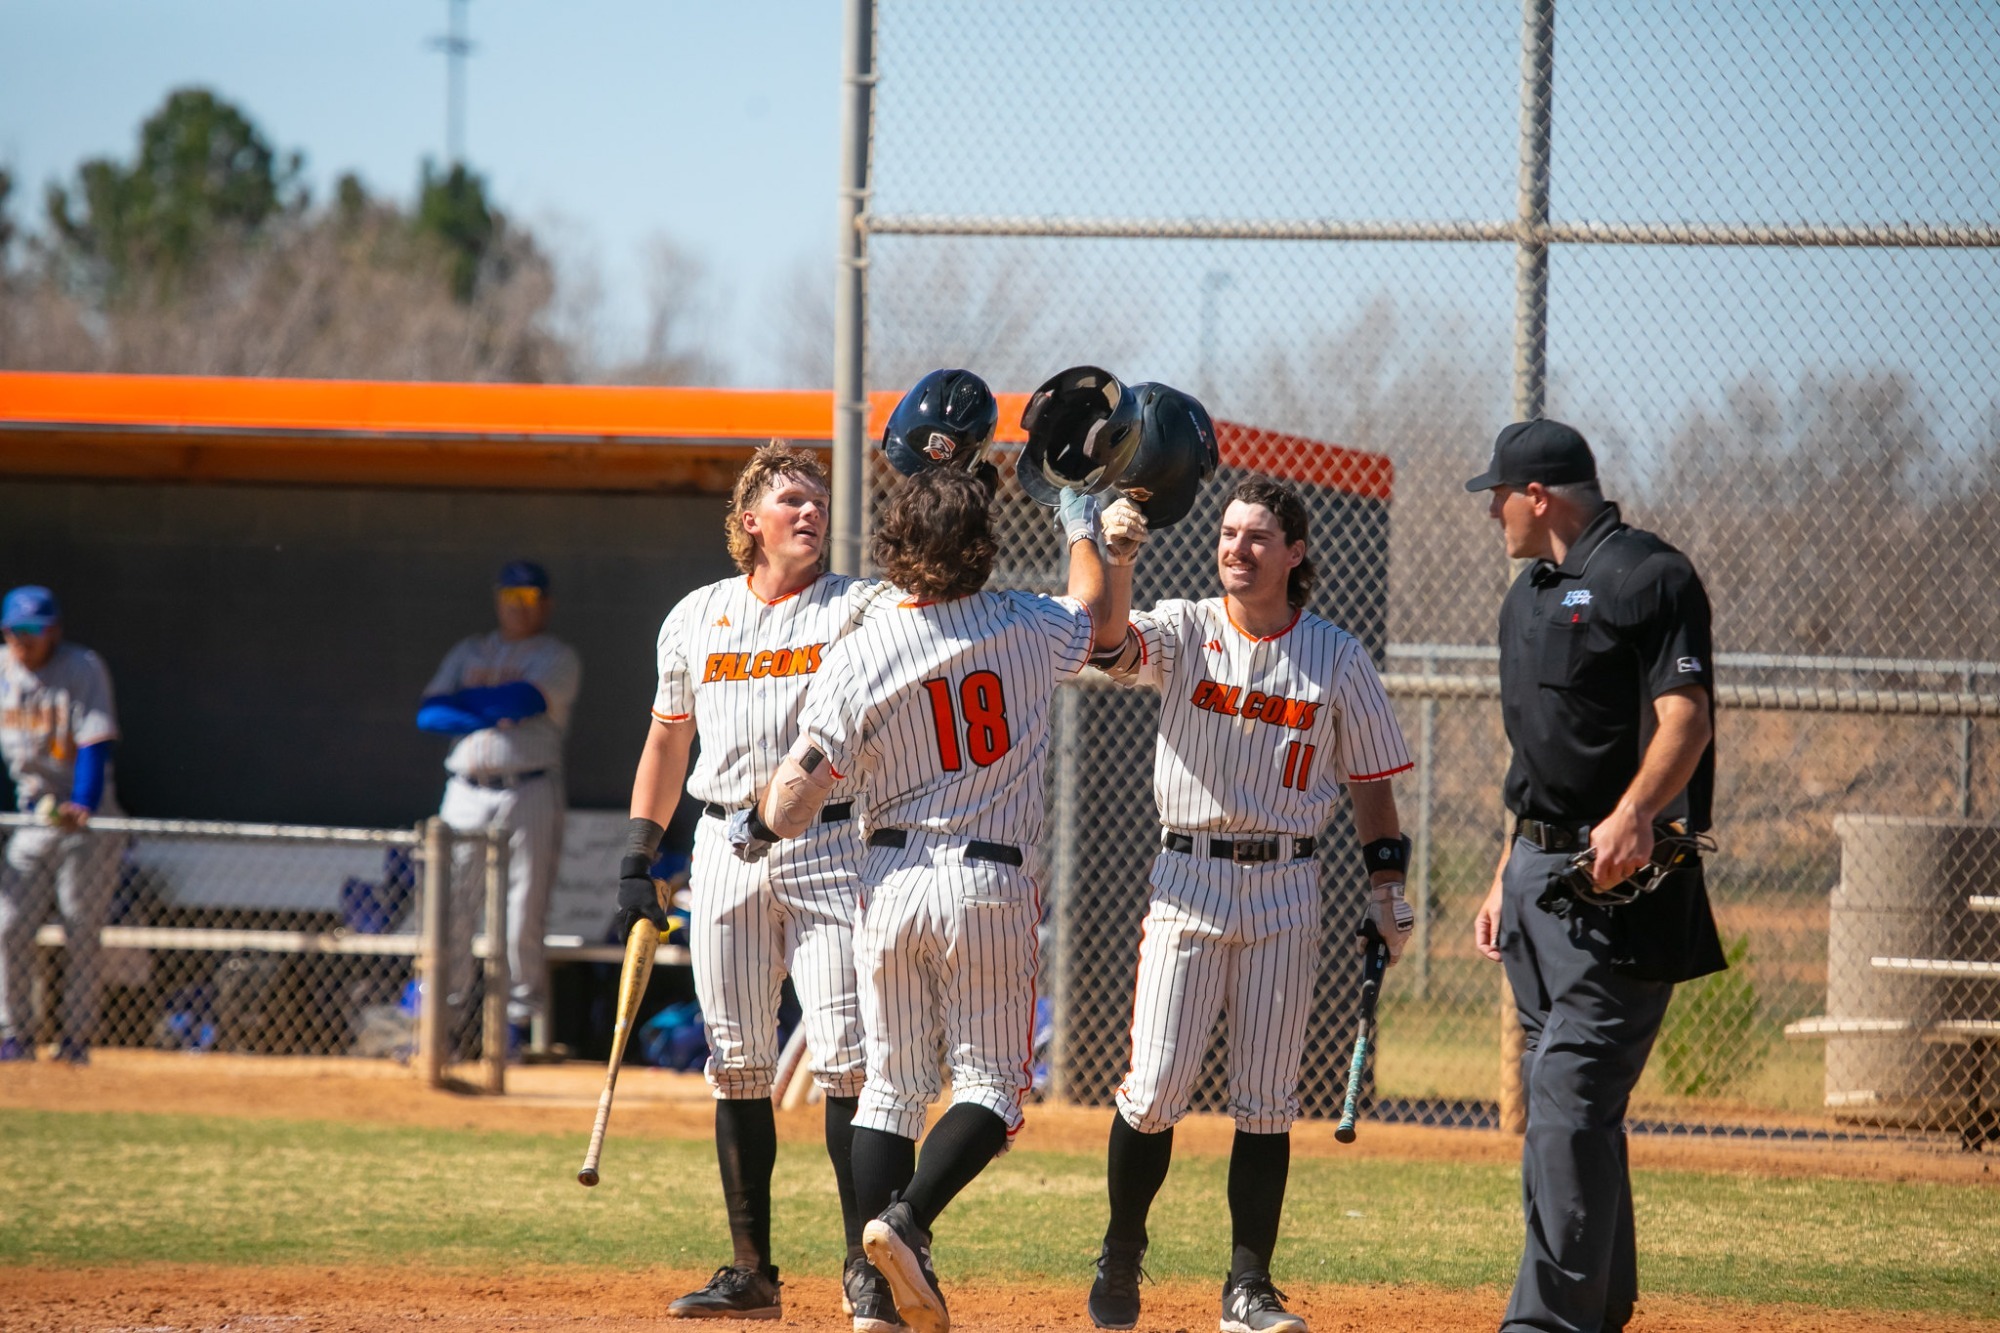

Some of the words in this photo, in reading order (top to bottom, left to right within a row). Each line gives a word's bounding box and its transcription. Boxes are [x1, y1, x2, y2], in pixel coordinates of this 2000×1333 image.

[702, 642, 829, 684] FALCONS
[922, 669, 1011, 772] 18
[1190, 679, 1325, 731] FALCONS
[1283, 741, 1315, 791] 11
